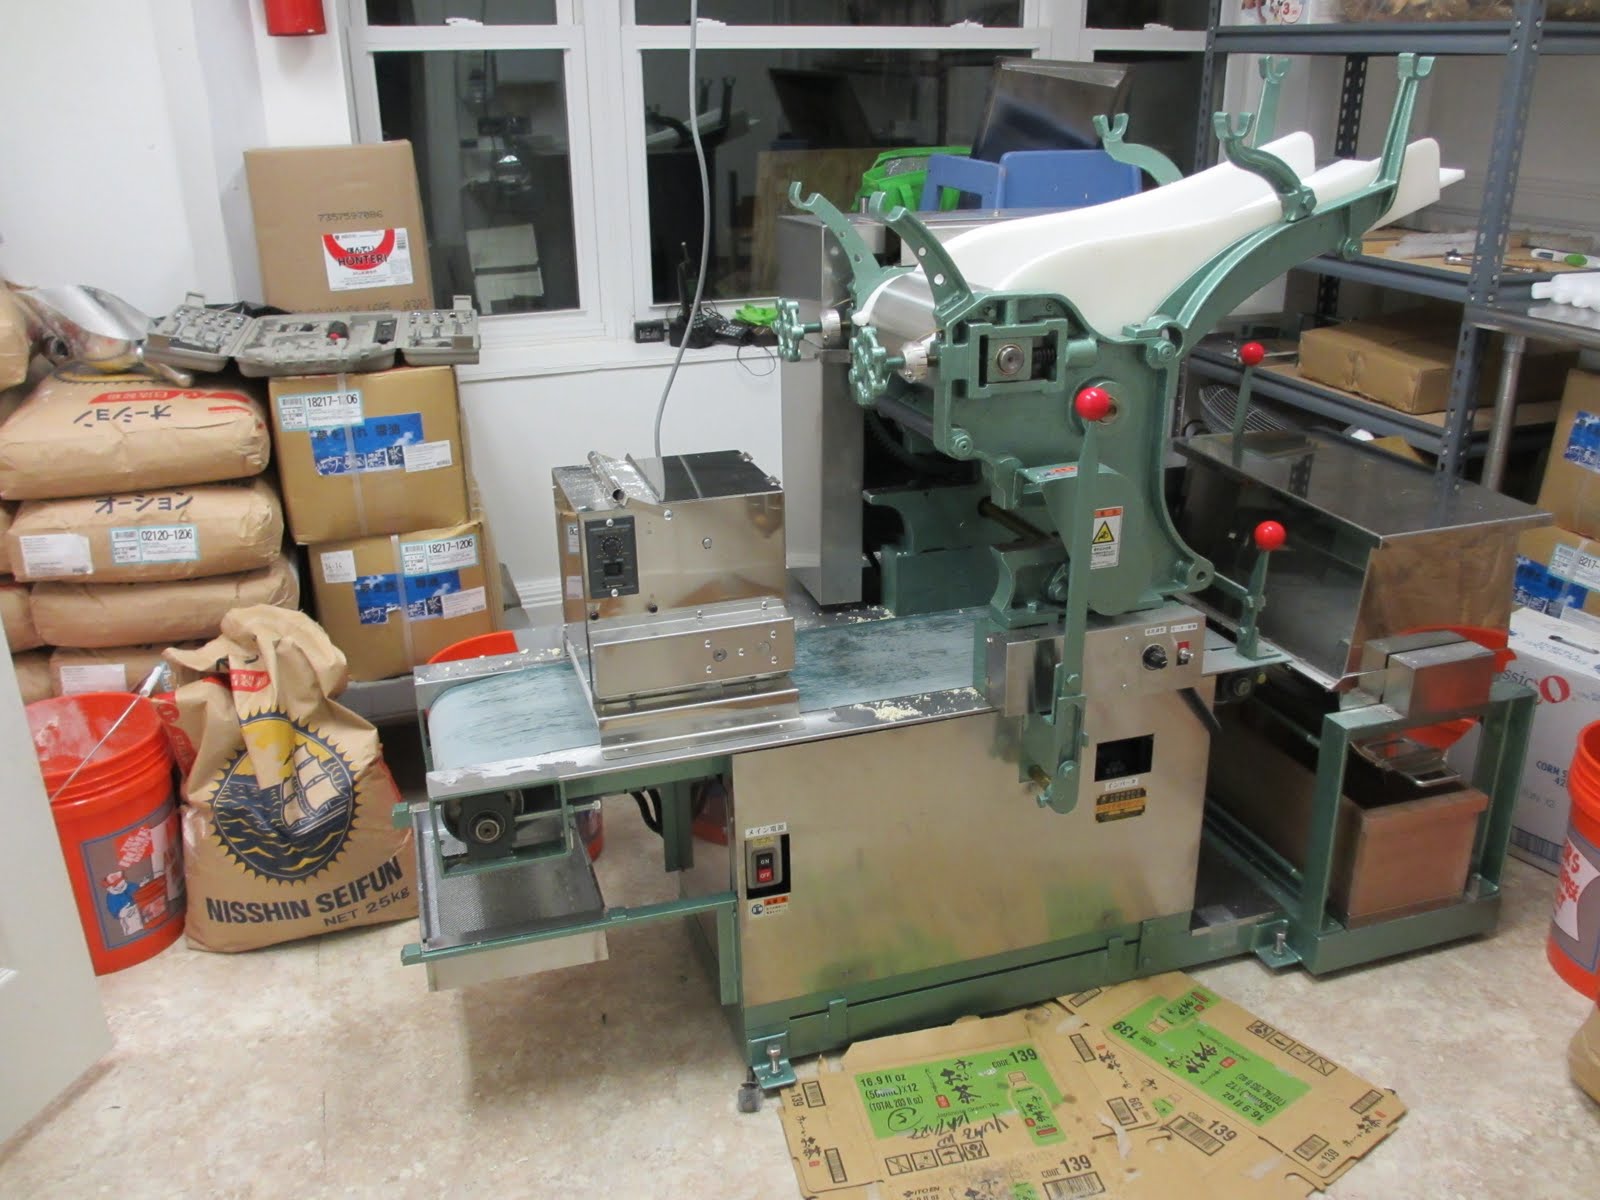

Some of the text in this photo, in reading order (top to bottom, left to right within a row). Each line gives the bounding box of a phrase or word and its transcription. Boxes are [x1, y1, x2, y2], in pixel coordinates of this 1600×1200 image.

[338, 254, 388, 266] HONTERI
[73, 404, 172, 428] オーション
[95, 491, 193, 514] オーション
[141, 527, 193, 542] 02120-1206
[427, 537, 474, 554] 18217-1206
[1578, 555, 1600, 570] 8217-
[760, 871, 771, 879] OFF
[205, 856, 403, 924] NISSHIN SEIFUN
[323, 908, 359, 927] NET
[1112, 1021, 1138, 1039] 139
[1009, 1048, 1038, 1064] 139
[860, 1076, 883, 1087] 16.9
[895, 1073, 907, 1082] oz
[790, 1093, 805, 1107] 139
[869, 1101, 893, 1113] (TOTAL
[1128, 1097, 1145, 1112] 139
[1242, 1104, 1265, 1121] 16.9
[1207, 1119, 1238, 1142] 139
[1060, 1154, 1092, 1173] 139
[1321, 1148, 1340, 1163] 139
